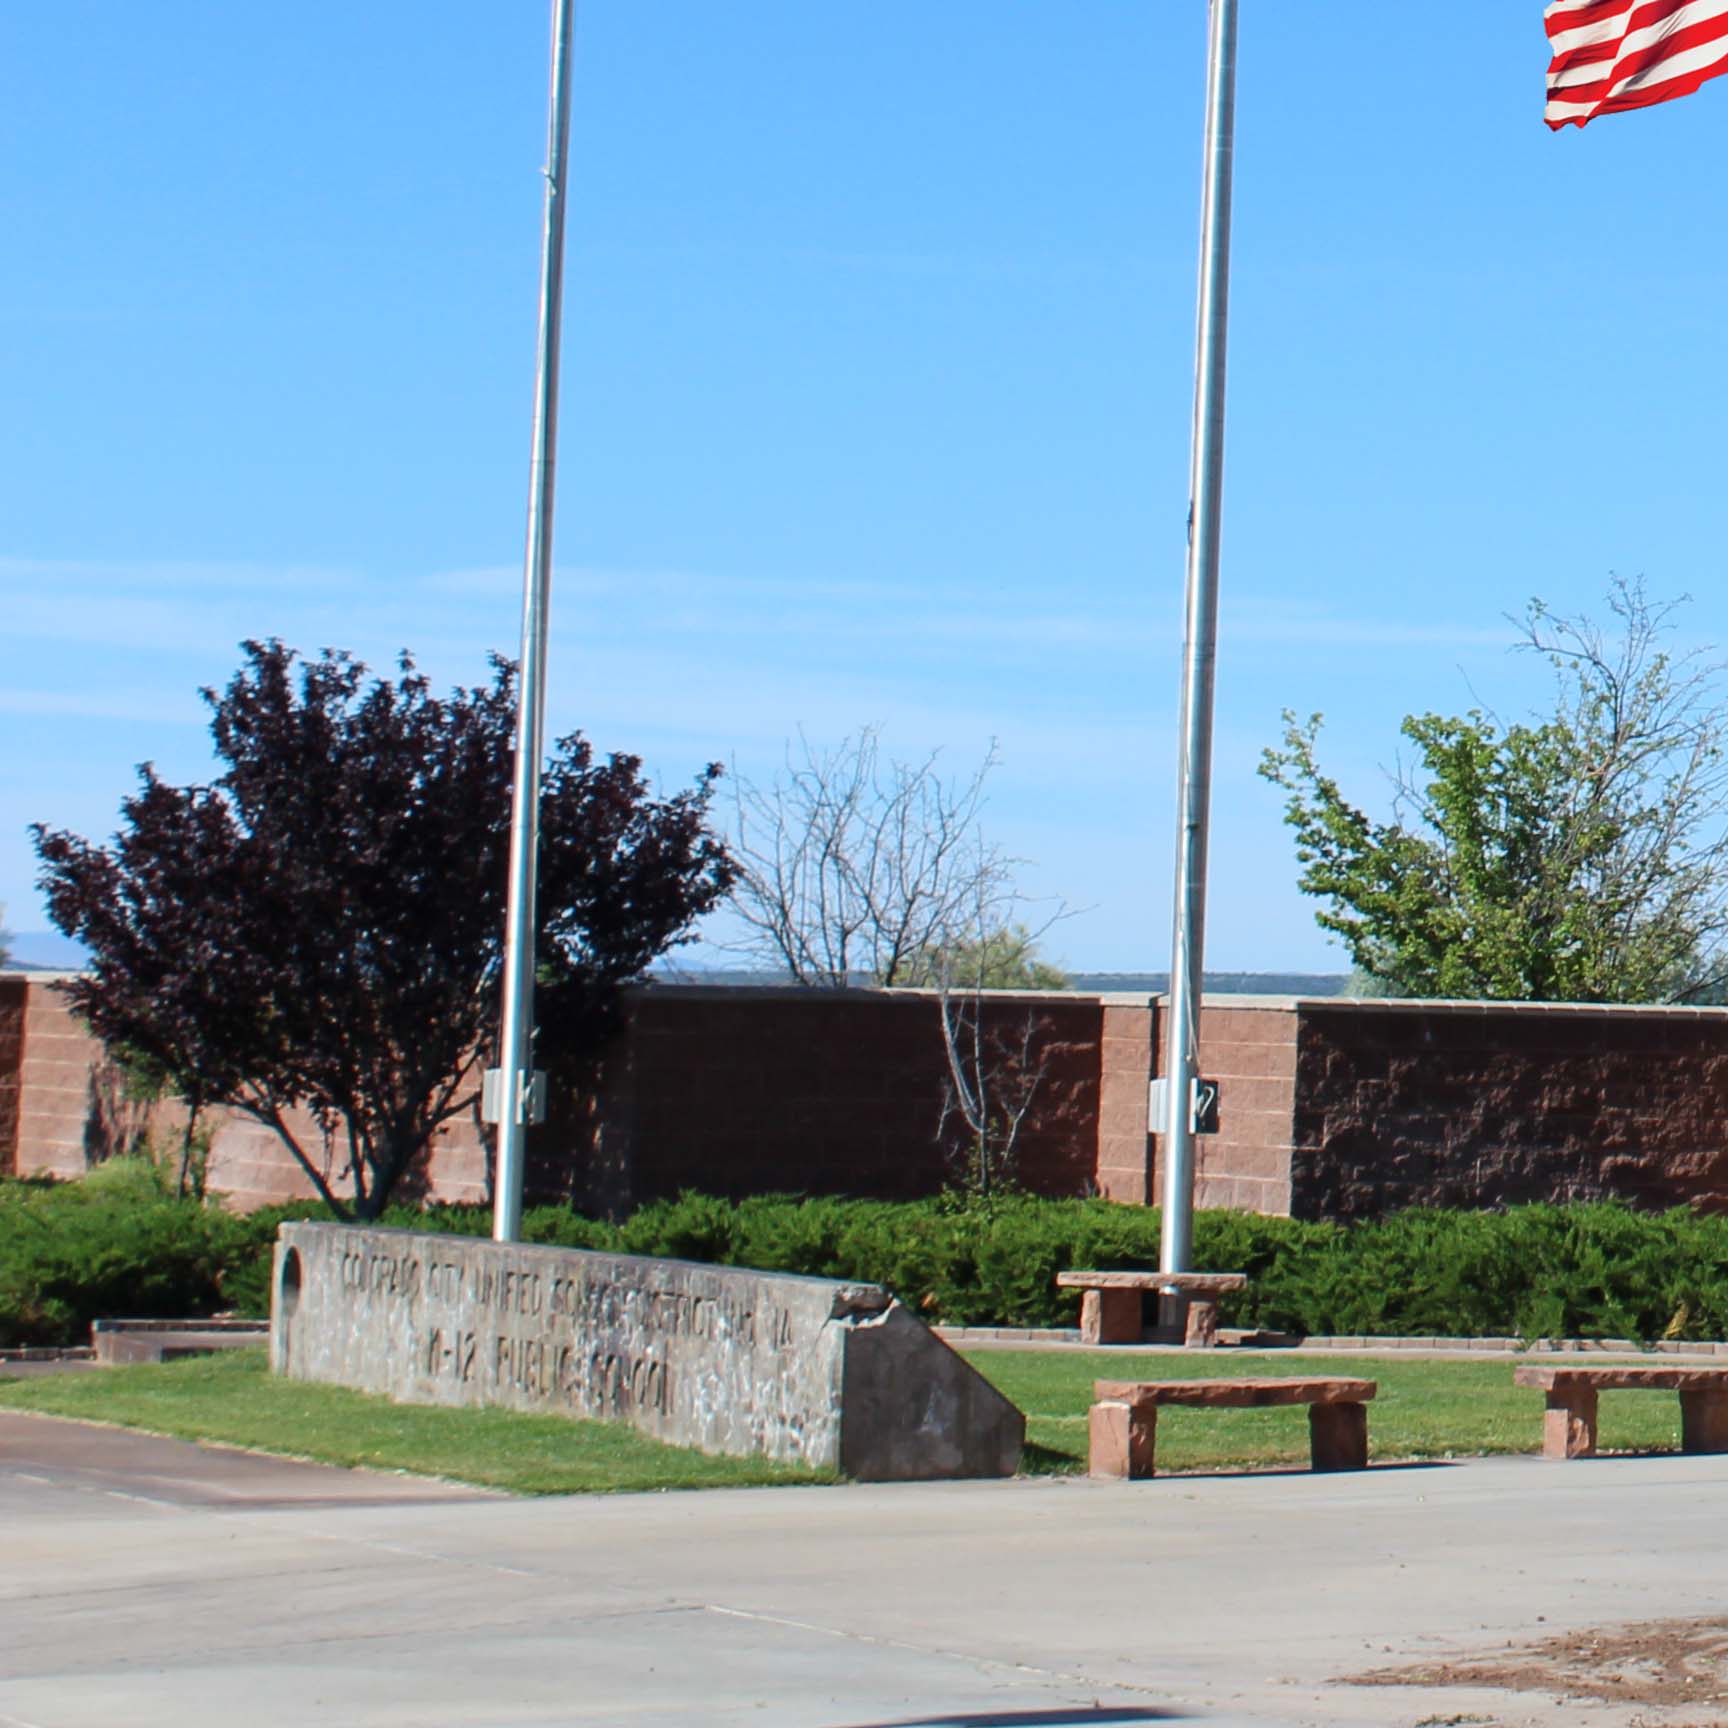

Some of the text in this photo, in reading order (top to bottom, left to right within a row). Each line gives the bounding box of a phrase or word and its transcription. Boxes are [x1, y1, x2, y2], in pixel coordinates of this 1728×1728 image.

[427, 1261, 465, 1305] CITY
[475, 1265, 543, 1316] UNIFIED
[495, 1334, 579, 1402] PUBLIC
